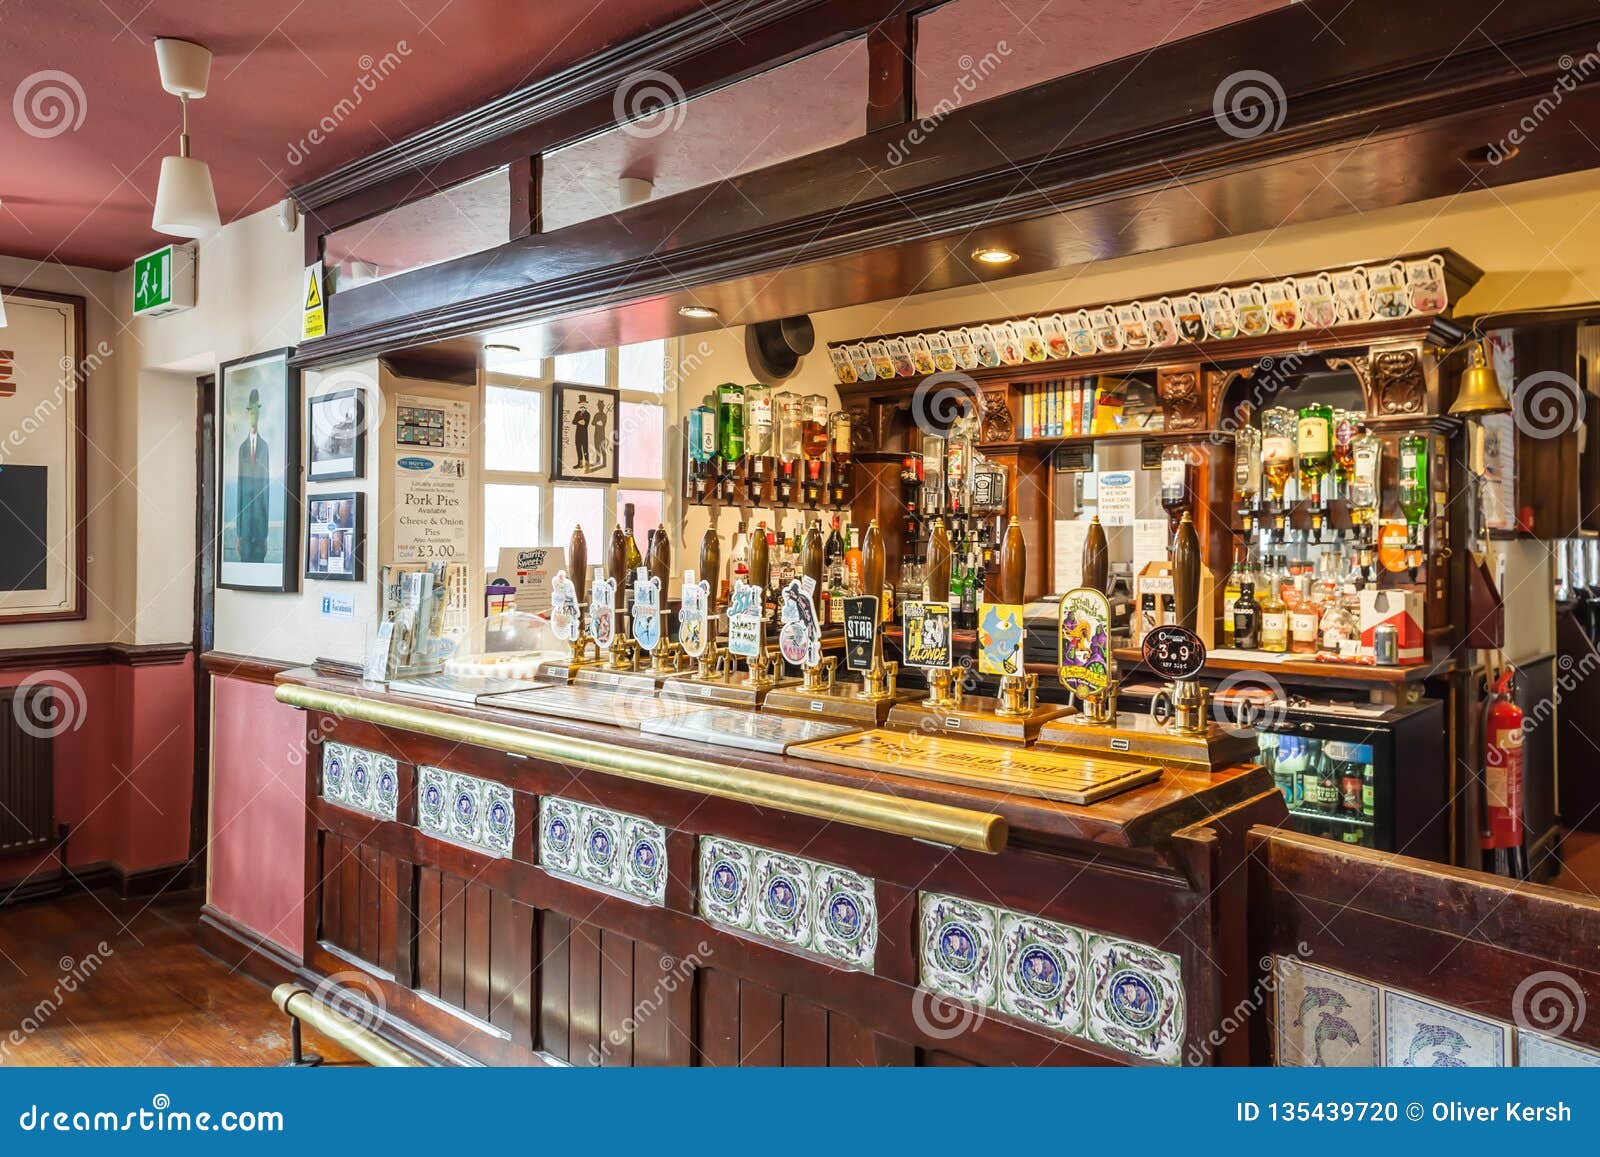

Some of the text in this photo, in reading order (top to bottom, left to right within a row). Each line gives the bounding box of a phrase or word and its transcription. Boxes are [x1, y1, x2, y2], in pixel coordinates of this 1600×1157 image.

[405, 493, 460, 506] Pork Pies
[400, 515, 464, 526] Cheese & Onion
[425, 527, 441, 536] Pies
[417, 544, 455, 558] £3.00
[732, 621, 757, 631] DAMMIT
[847, 620, 872, 639] STAR
[909, 647, 947, 660] BLONDE
